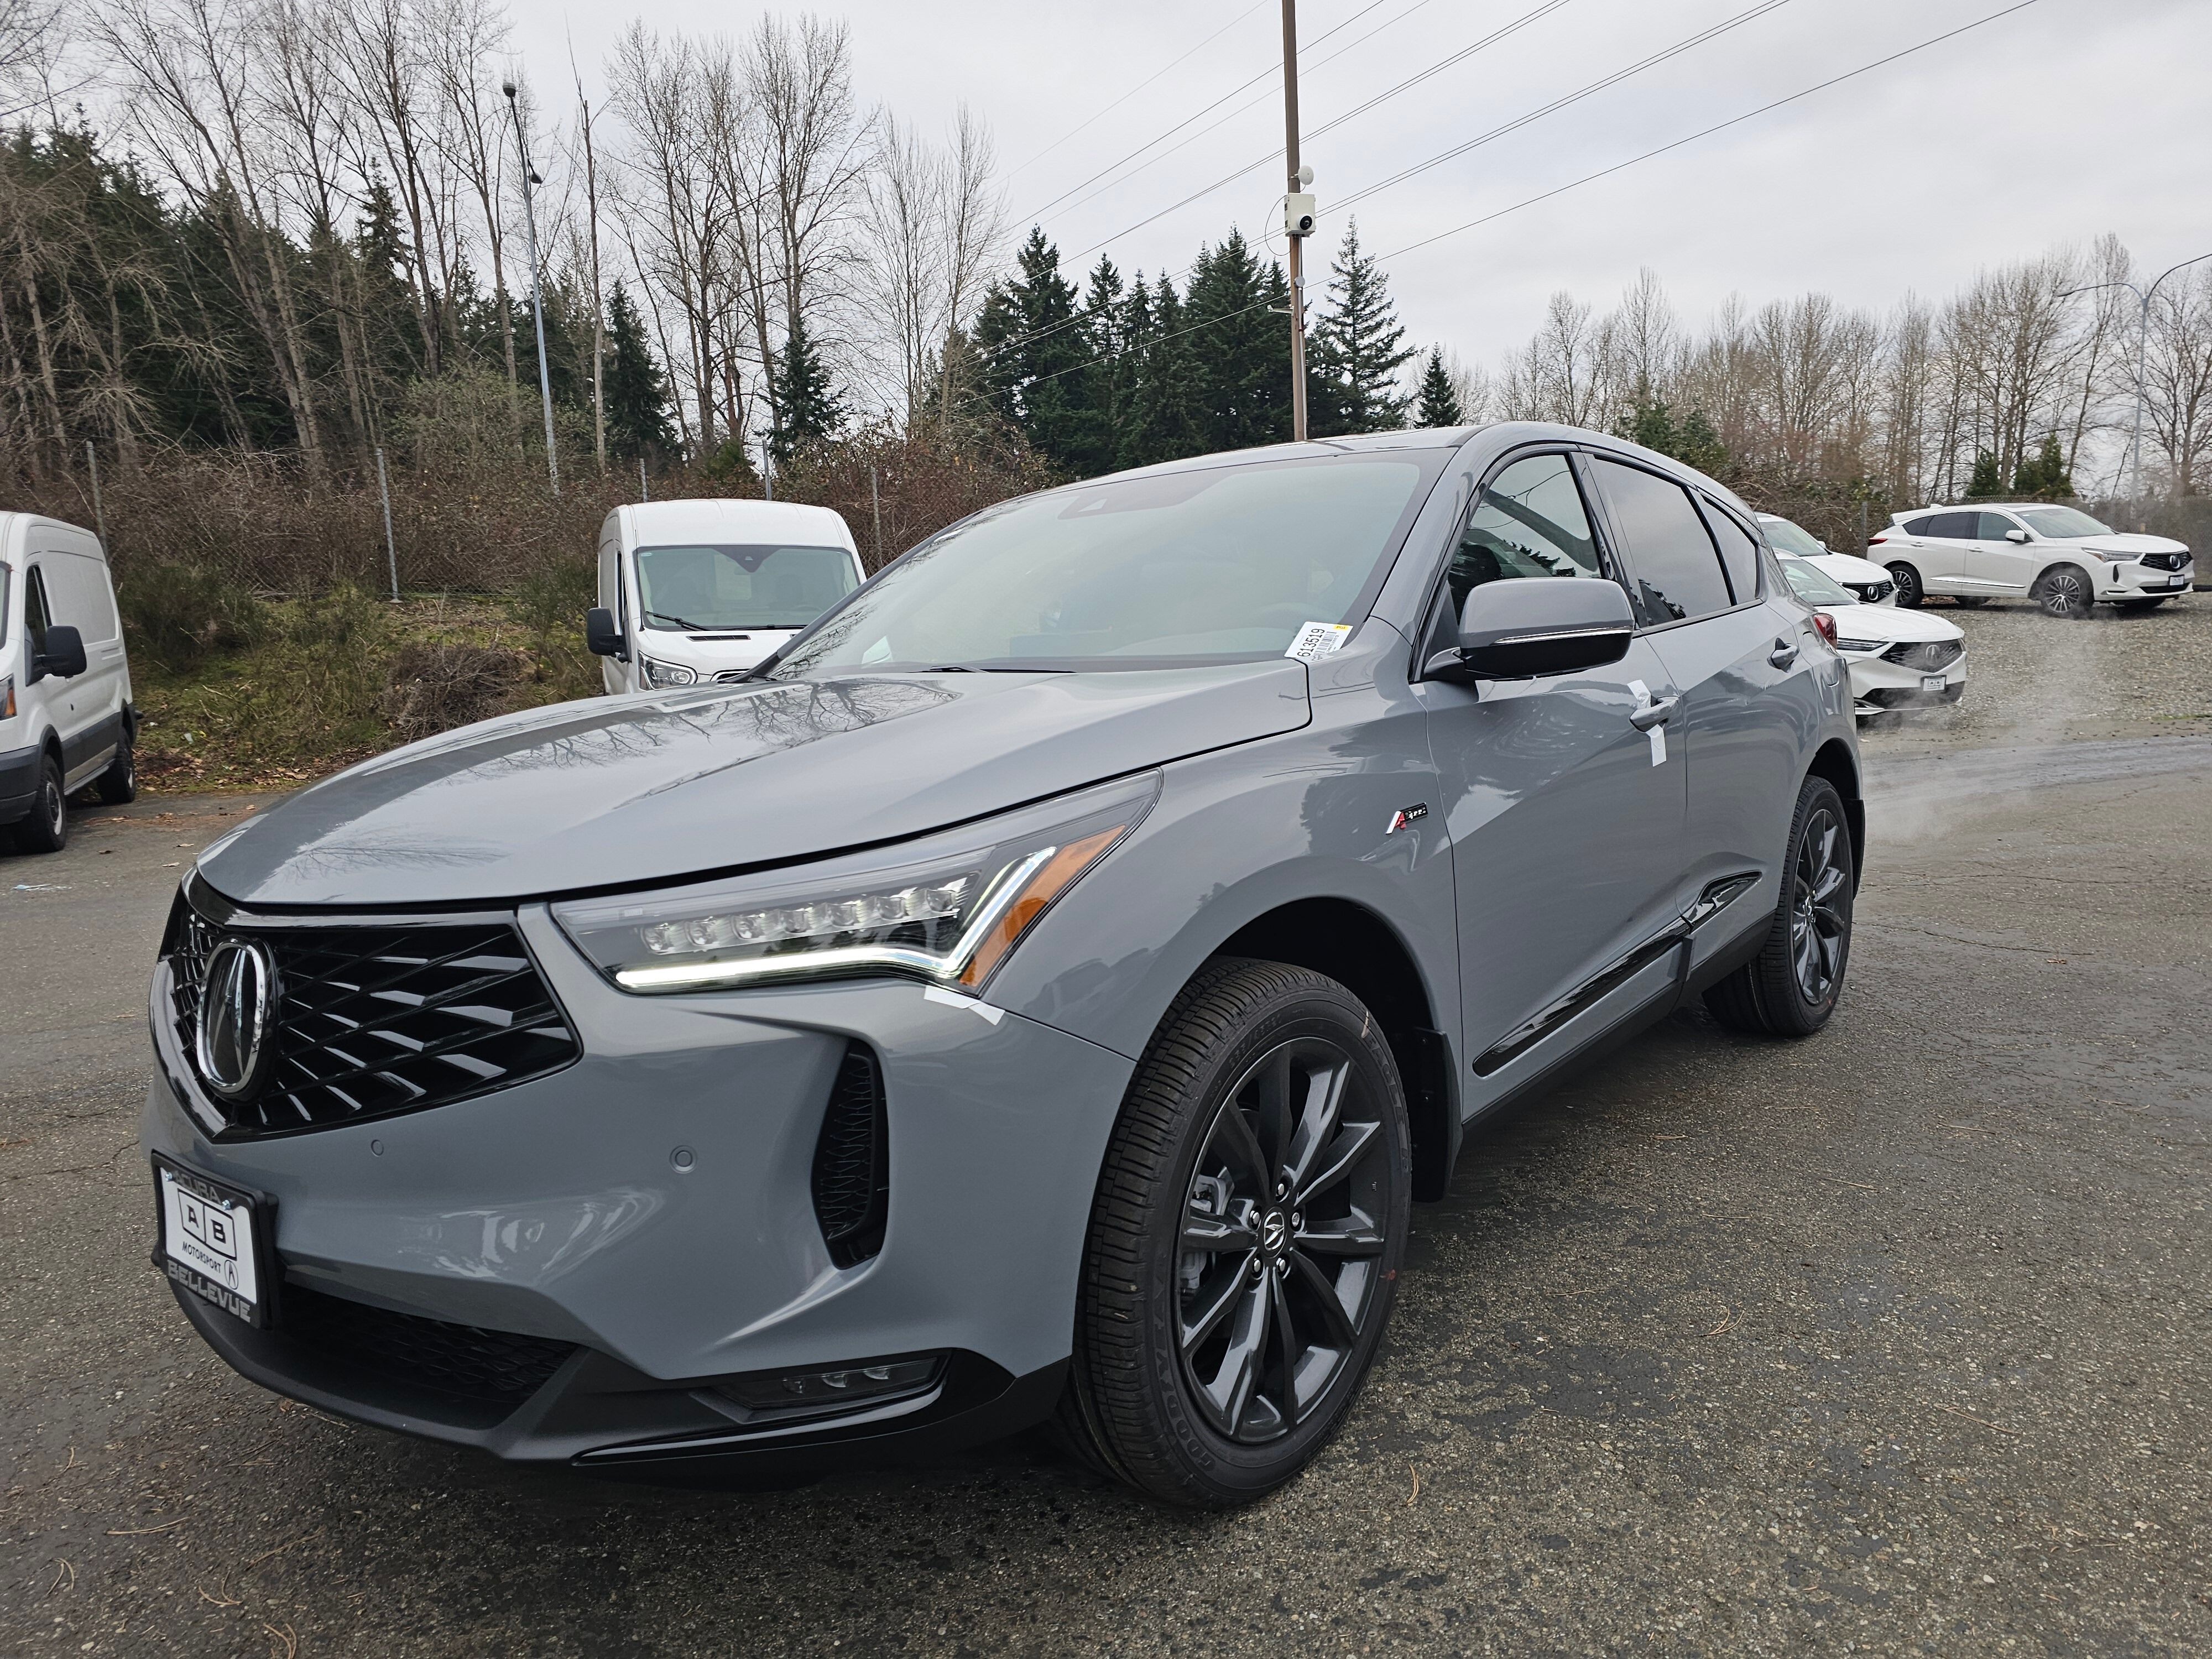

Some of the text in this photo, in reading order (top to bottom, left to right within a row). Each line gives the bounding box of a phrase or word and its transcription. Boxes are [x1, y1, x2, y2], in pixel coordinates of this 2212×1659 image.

[1297, 628, 1325, 657] 613519
[173, 1170, 221, 1204] ACURA
[186, 1204, 226, 1244] A B
[182, 1241, 221, 1274] MOTORSPORT
[167, 1259, 251, 1323] BELLEVUE
